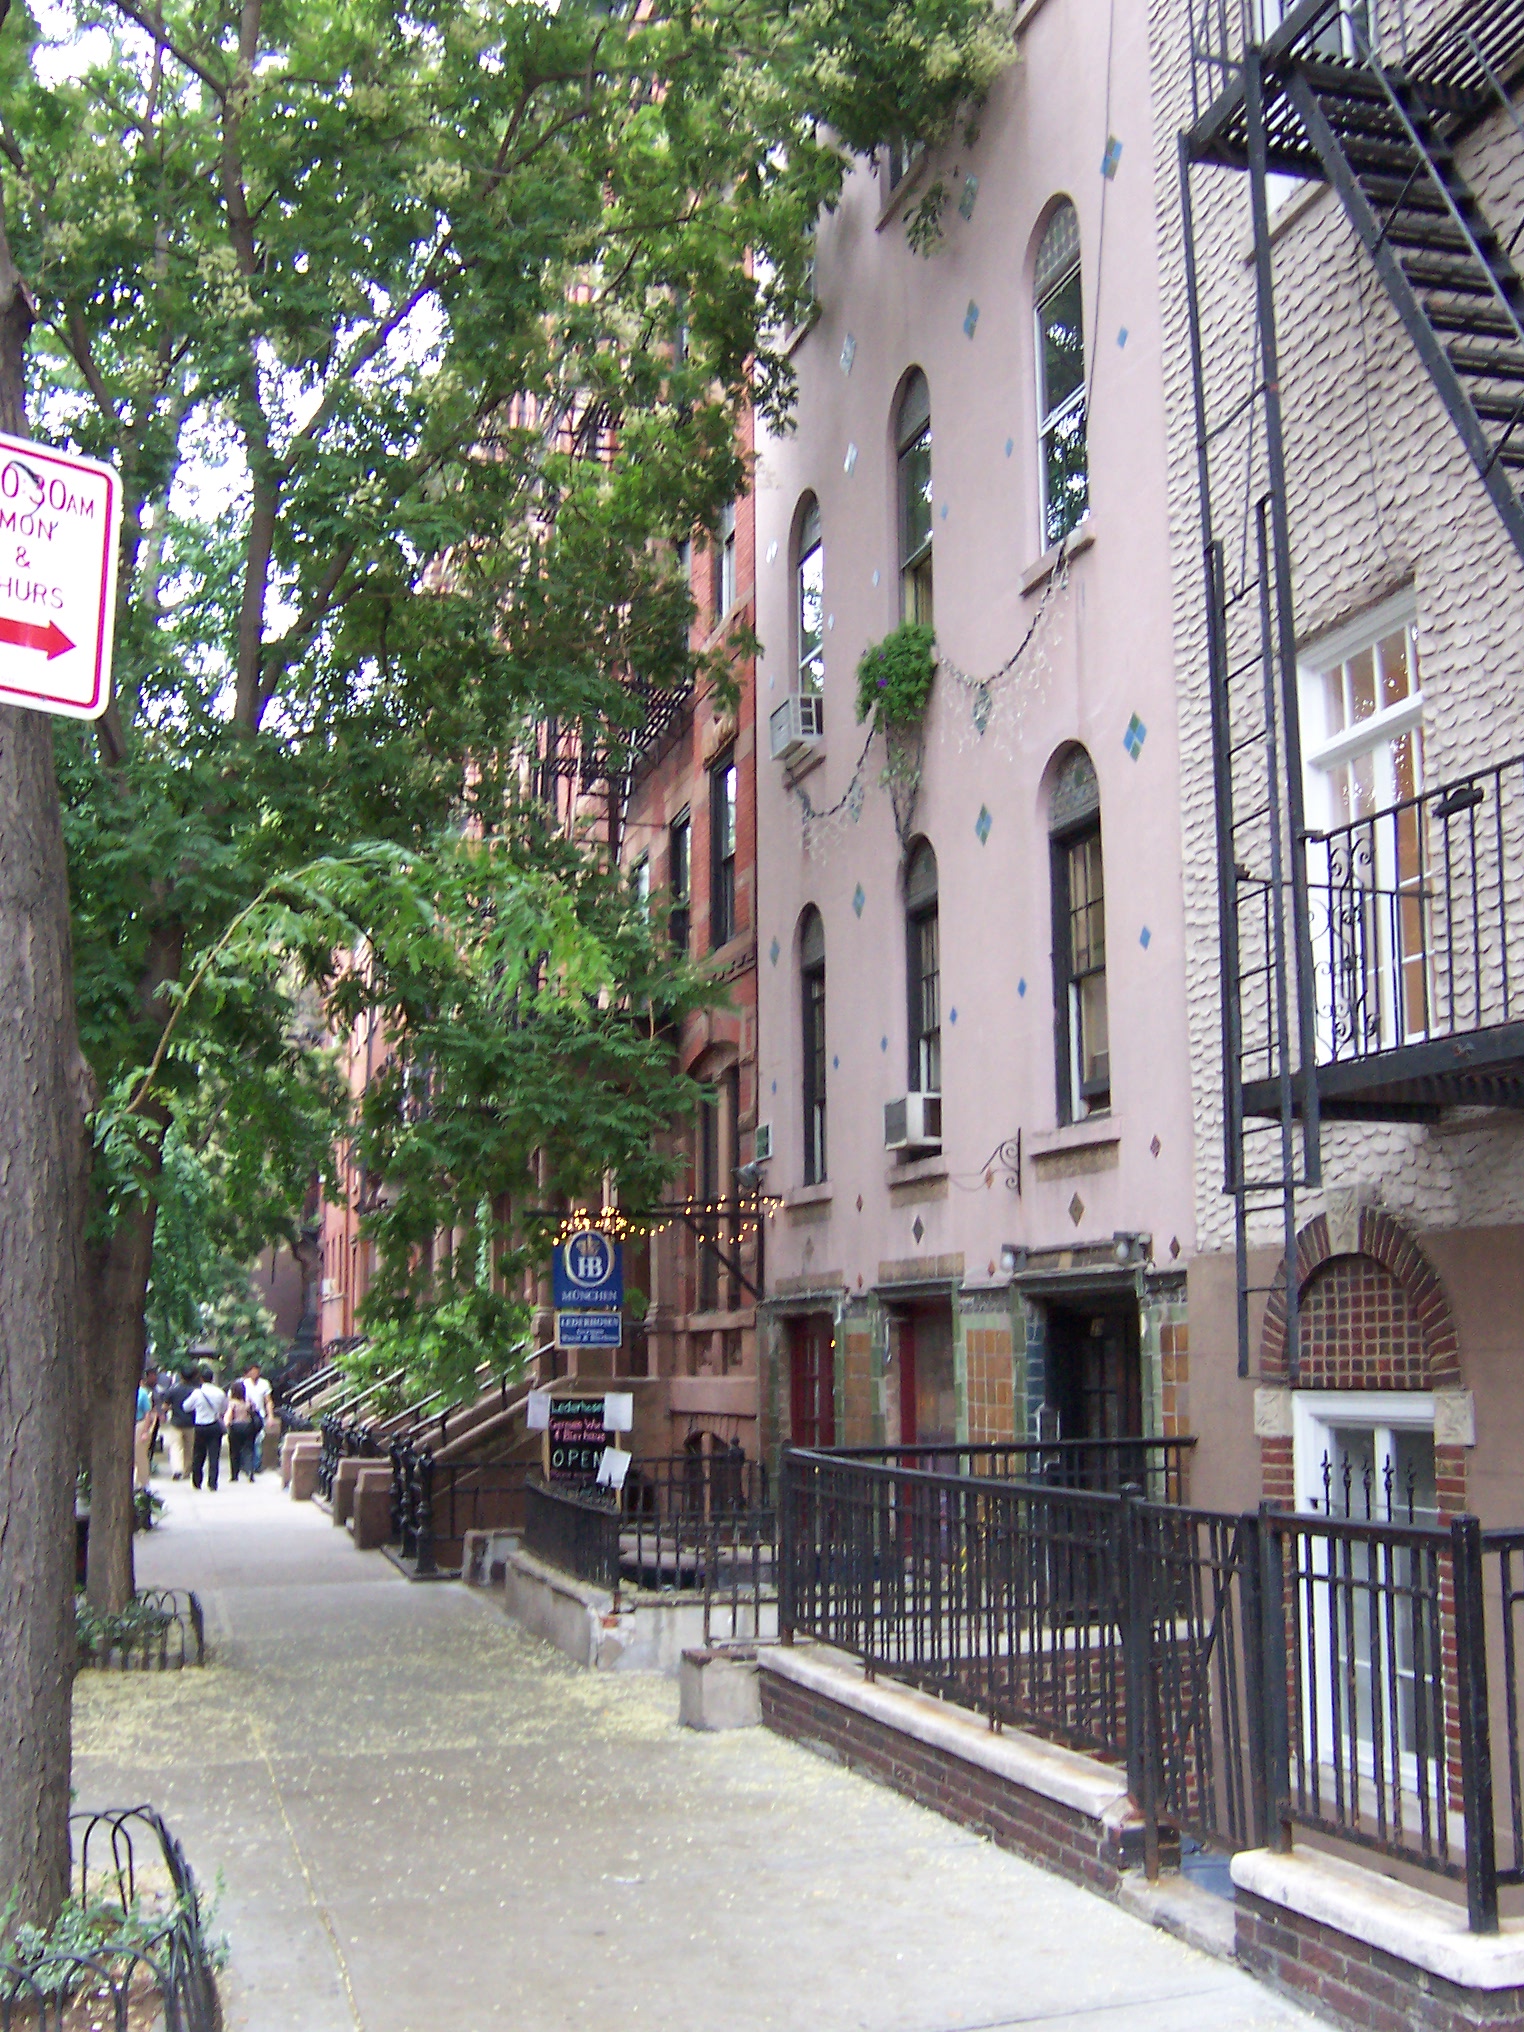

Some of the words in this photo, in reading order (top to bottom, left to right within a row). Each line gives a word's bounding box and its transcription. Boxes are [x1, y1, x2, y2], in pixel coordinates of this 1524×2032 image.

[0, 508, 53, 541] MON
[15, 546, 31, 568] &
[577, 1256, 603, 1279] HB
[552, 1448, 604, 1469] OPEN
